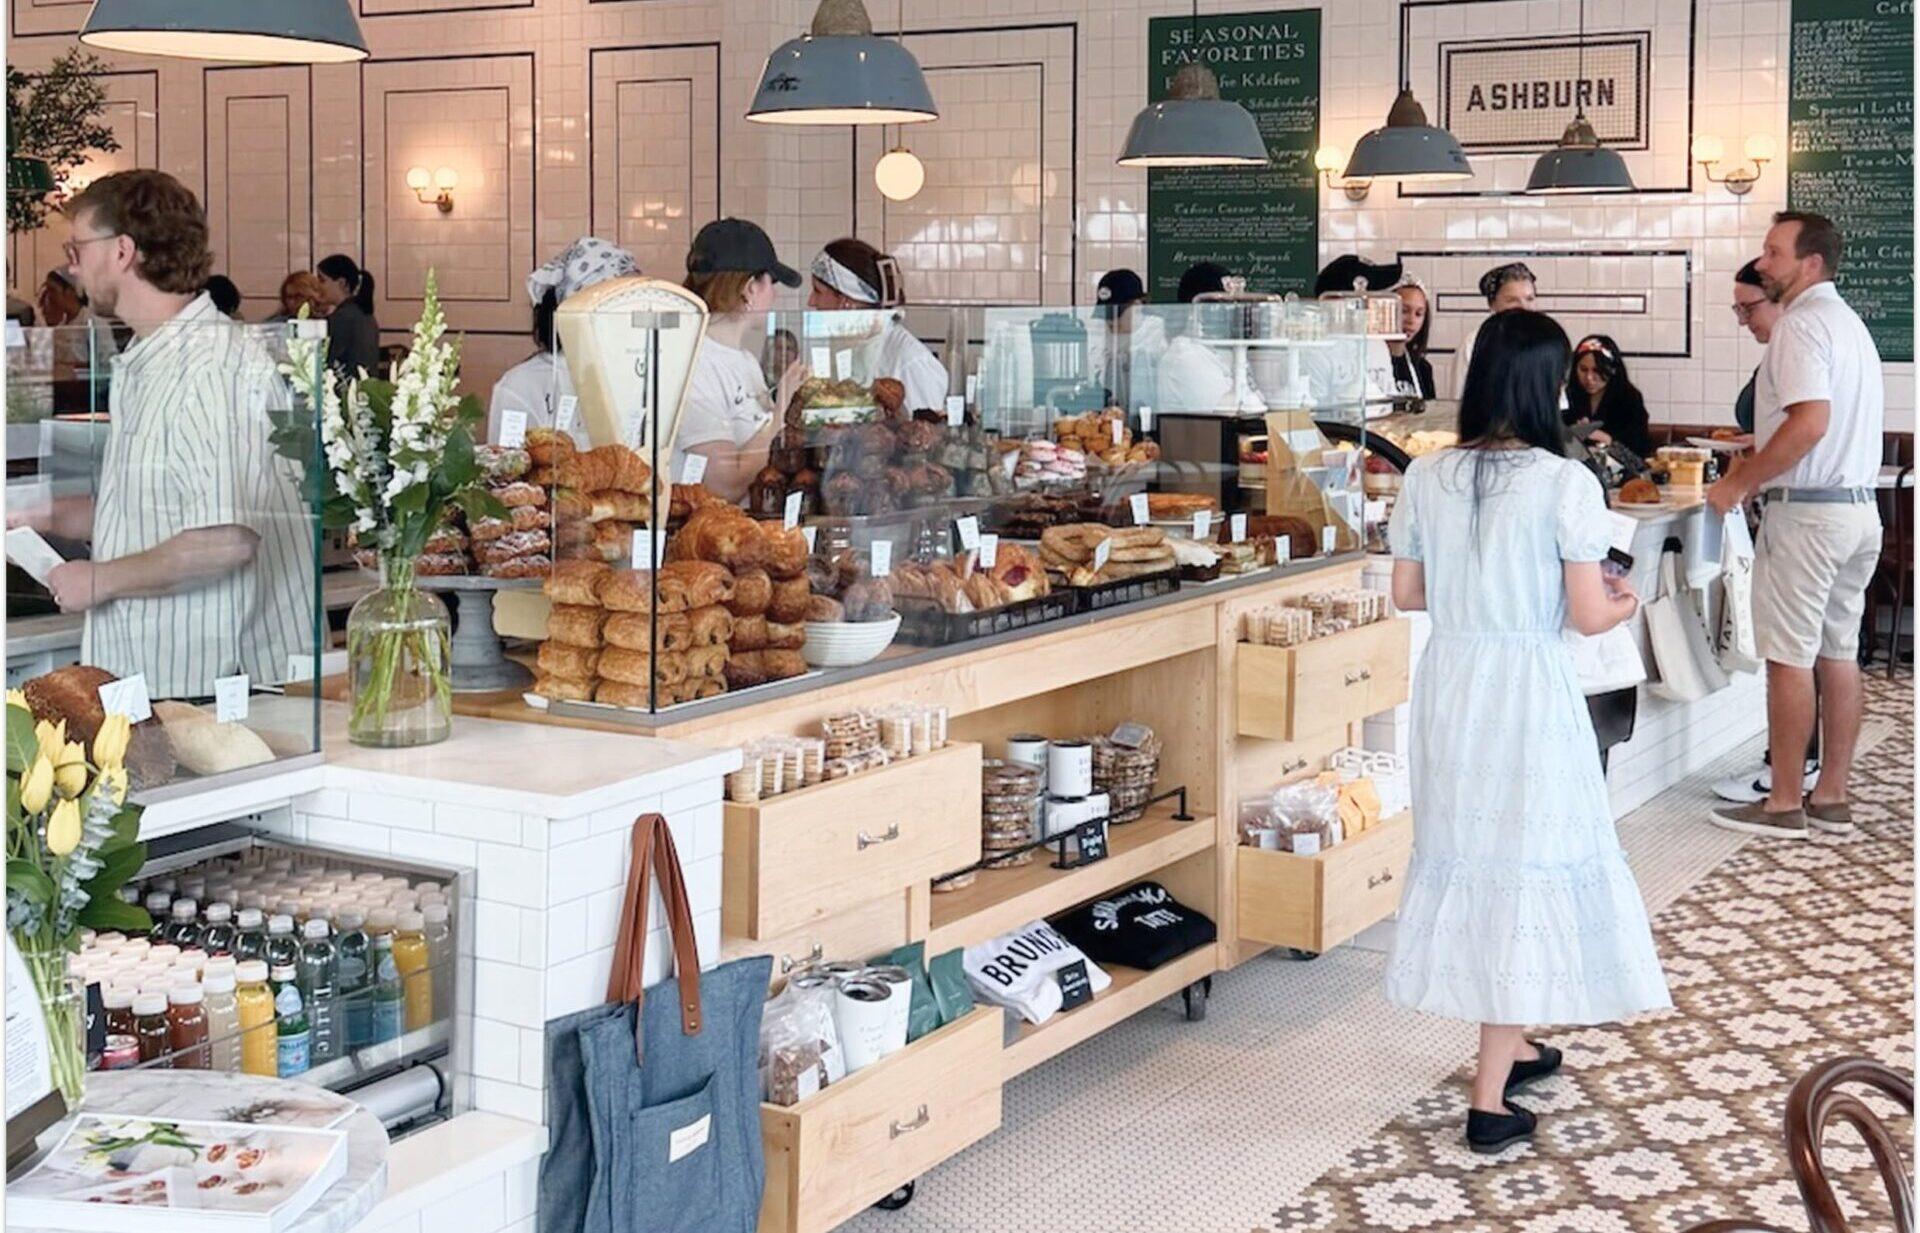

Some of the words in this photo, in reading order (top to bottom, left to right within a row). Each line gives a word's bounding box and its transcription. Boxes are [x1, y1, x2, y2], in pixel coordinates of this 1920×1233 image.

[1169, 24, 1299, 45] SEASONAL
[1242, 71, 1301, 88] Kitchen
[1467, 78, 1614, 111] ASHBURN
[1808, 102, 1864, 118] Special
[1841, 154, 1874, 168] Tea
[1835, 273, 1889, 286] Juices
